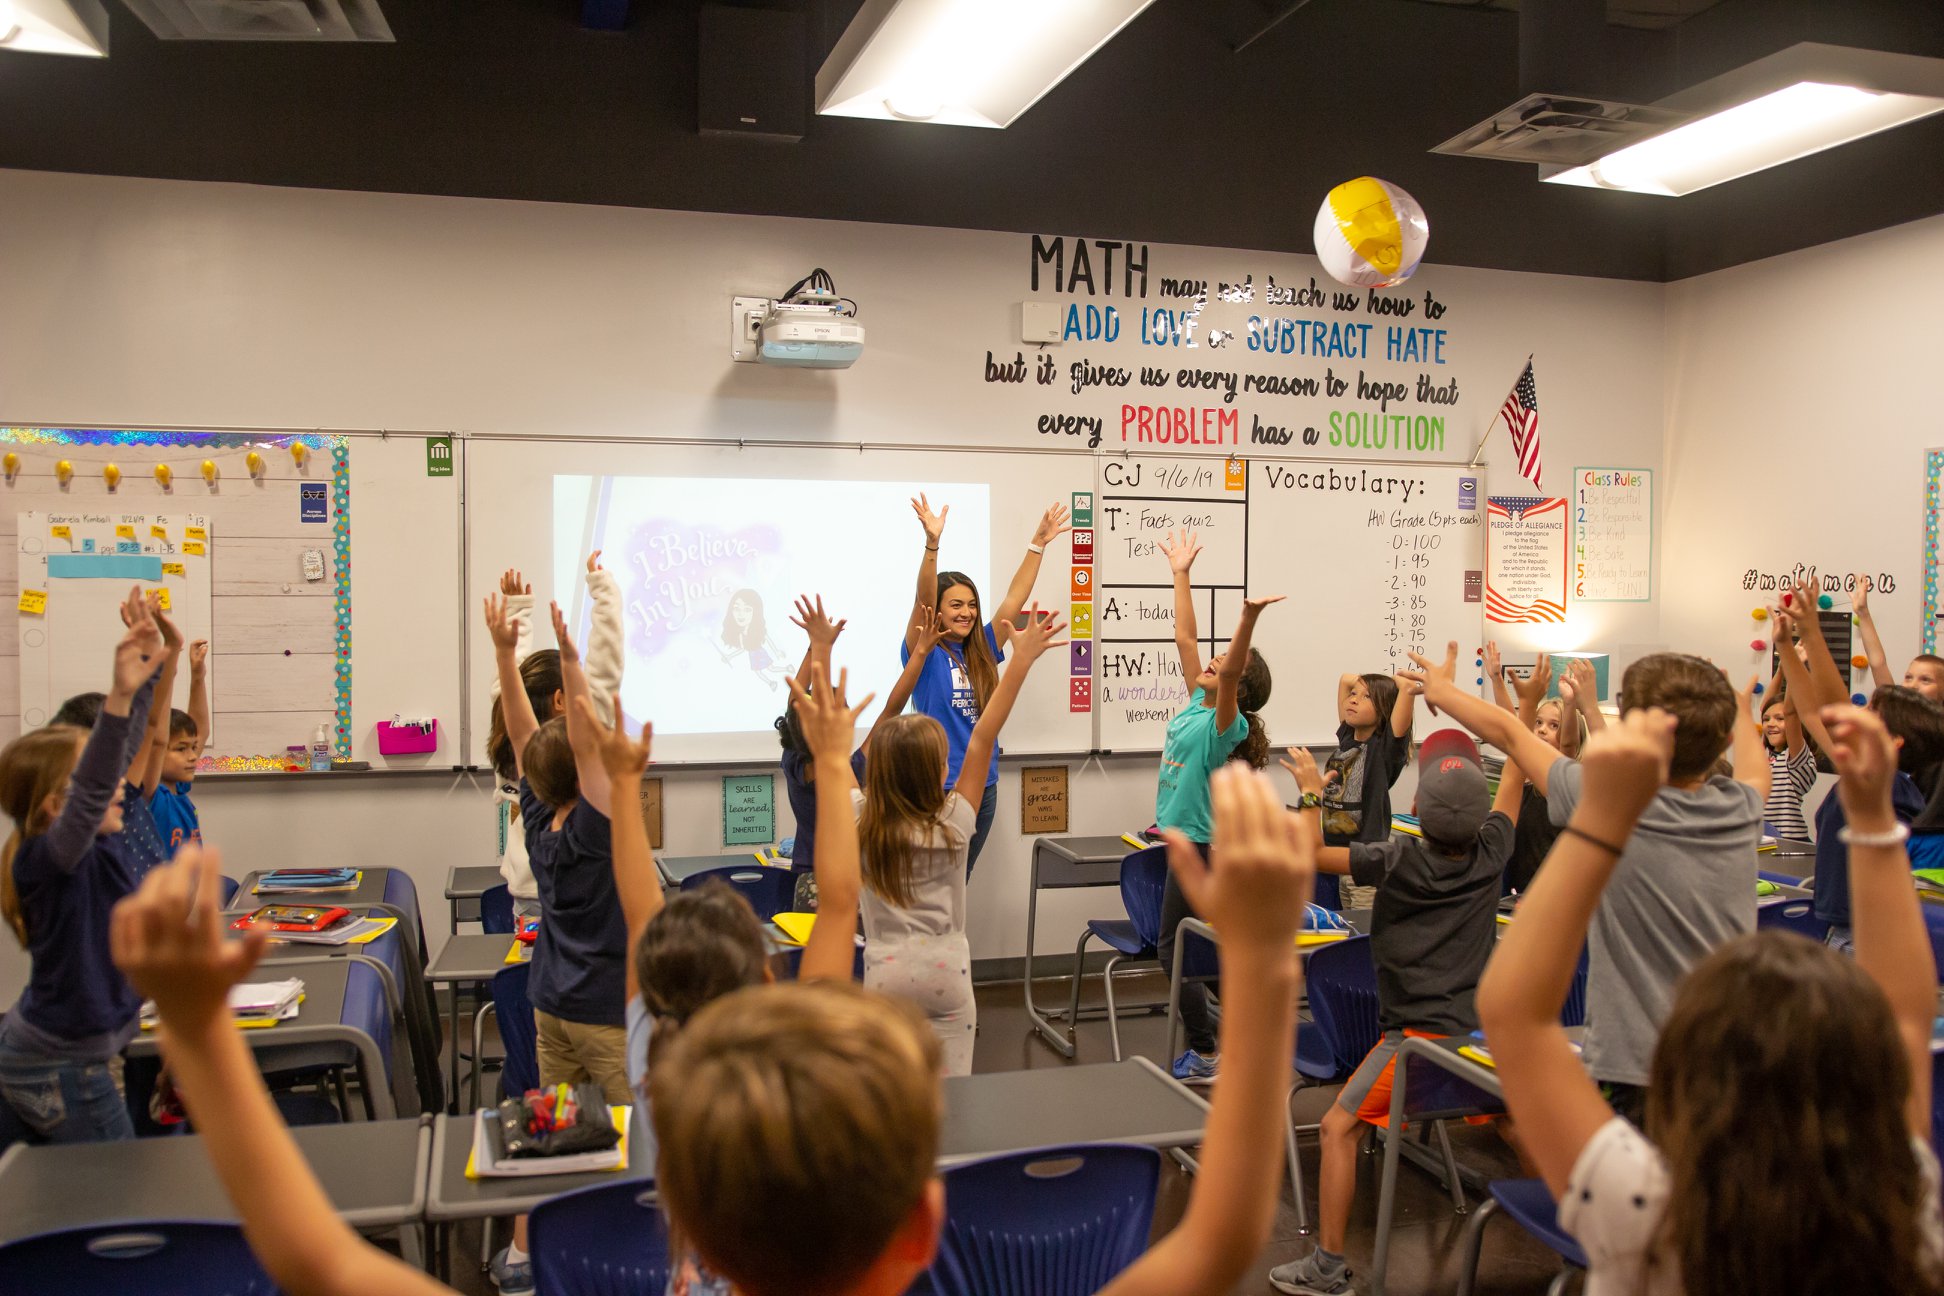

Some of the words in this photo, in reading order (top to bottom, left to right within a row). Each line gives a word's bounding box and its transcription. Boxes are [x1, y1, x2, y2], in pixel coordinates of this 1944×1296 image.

[1031, 234, 1148, 298] MATH
[1159, 277, 1208, 312] may
[1266, 274, 1325, 307] teach
[1332, 288, 1360, 311] us
[1366, 287, 1415, 318] how
[1424, 290, 1447, 320] to
[1064, 303, 1119, 342] ADD
[1142, 306, 1199, 349] LOVE
[1208, 329, 1234, 348] or
[1247, 315, 1373, 359] SUBTRACT
[1387, 326, 1447, 364] HATE
[985, 351, 1027, 384] but
[1036, 353, 1057, 385] it
[1070, 358, 1132, 395] gives
[1140, 366, 1169, 387] us
[1176, 368, 1238, 403] every
[1244, 374, 1319, 397] reason
[1325, 368, 1348, 397] to
[1357, 370, 1408, 412] hope
[1416, 373, 1459, 405] that
[1038, 413, 1103, 448] every
[1121, 404, 1238, 445] PROBLEM
[1251, 413, 1293, 445] has
[1303, 426, 1319, 445] a
[1328, 410, 1444, 452] SOLUTION
[1104, 463, 1141, 487] CJ
[1154, 464, 1213, 489] 9/6/19
[1265, 466, 1425, 503] Vocabulary:
[1585, 472, 1611, 486] Class
[1614, 472, 1642, 487] Rules
[1579, 489, 1588, 504] 1.
[1588, 488, 1599, 504] Be
[1104, 507, 1130, 531] T:
[1140, 508, 1175, 531] Facts
[1183, 512, 1215, 533] quiz
[1368, 509, 1385, 528] HW
[1390, 509, 1425, 528] Grade
[1459, 514, 1483, 528] each)
[1577, 508, 1588, 523] 2.
[1588, 507, 1600, 523] Be
[1490, 521, 1513, 529] PLEDGE
[1525, 522, 1563, 530] ALLEGIANCE
[1579, 526, 1587, 541] 3.
[1588, 525, 1601, 542] Be
[1606, 523, 1625, 541] Kind
[84, 540, 92, 551] 5
[649, 531, 758, 571] Believe
[1124, 537, 1156, 559] Test
[1577, 545, 1587, 560] 4.
[1588, 544, 1602, 561] Be
[1605, 545, 1625, 560] Safe
[1577, 563, 1587, 578] 5.
[1586, 563, 1597, 578] Be
[1619, 567, 1627, 578] to
[1629, 563, 1648, 578] Learn
[1577, 582, 1586, 597] 6.
[1103, 597, 1128, 621] A:
[1102, 652, 1151, 677] HW:
[1103, 686, 1113, 702] a
[735, 785, 762, 793] SKILLS
[729, 803, 770, 813] learned,
[1027, 792, 1064, 806] great
